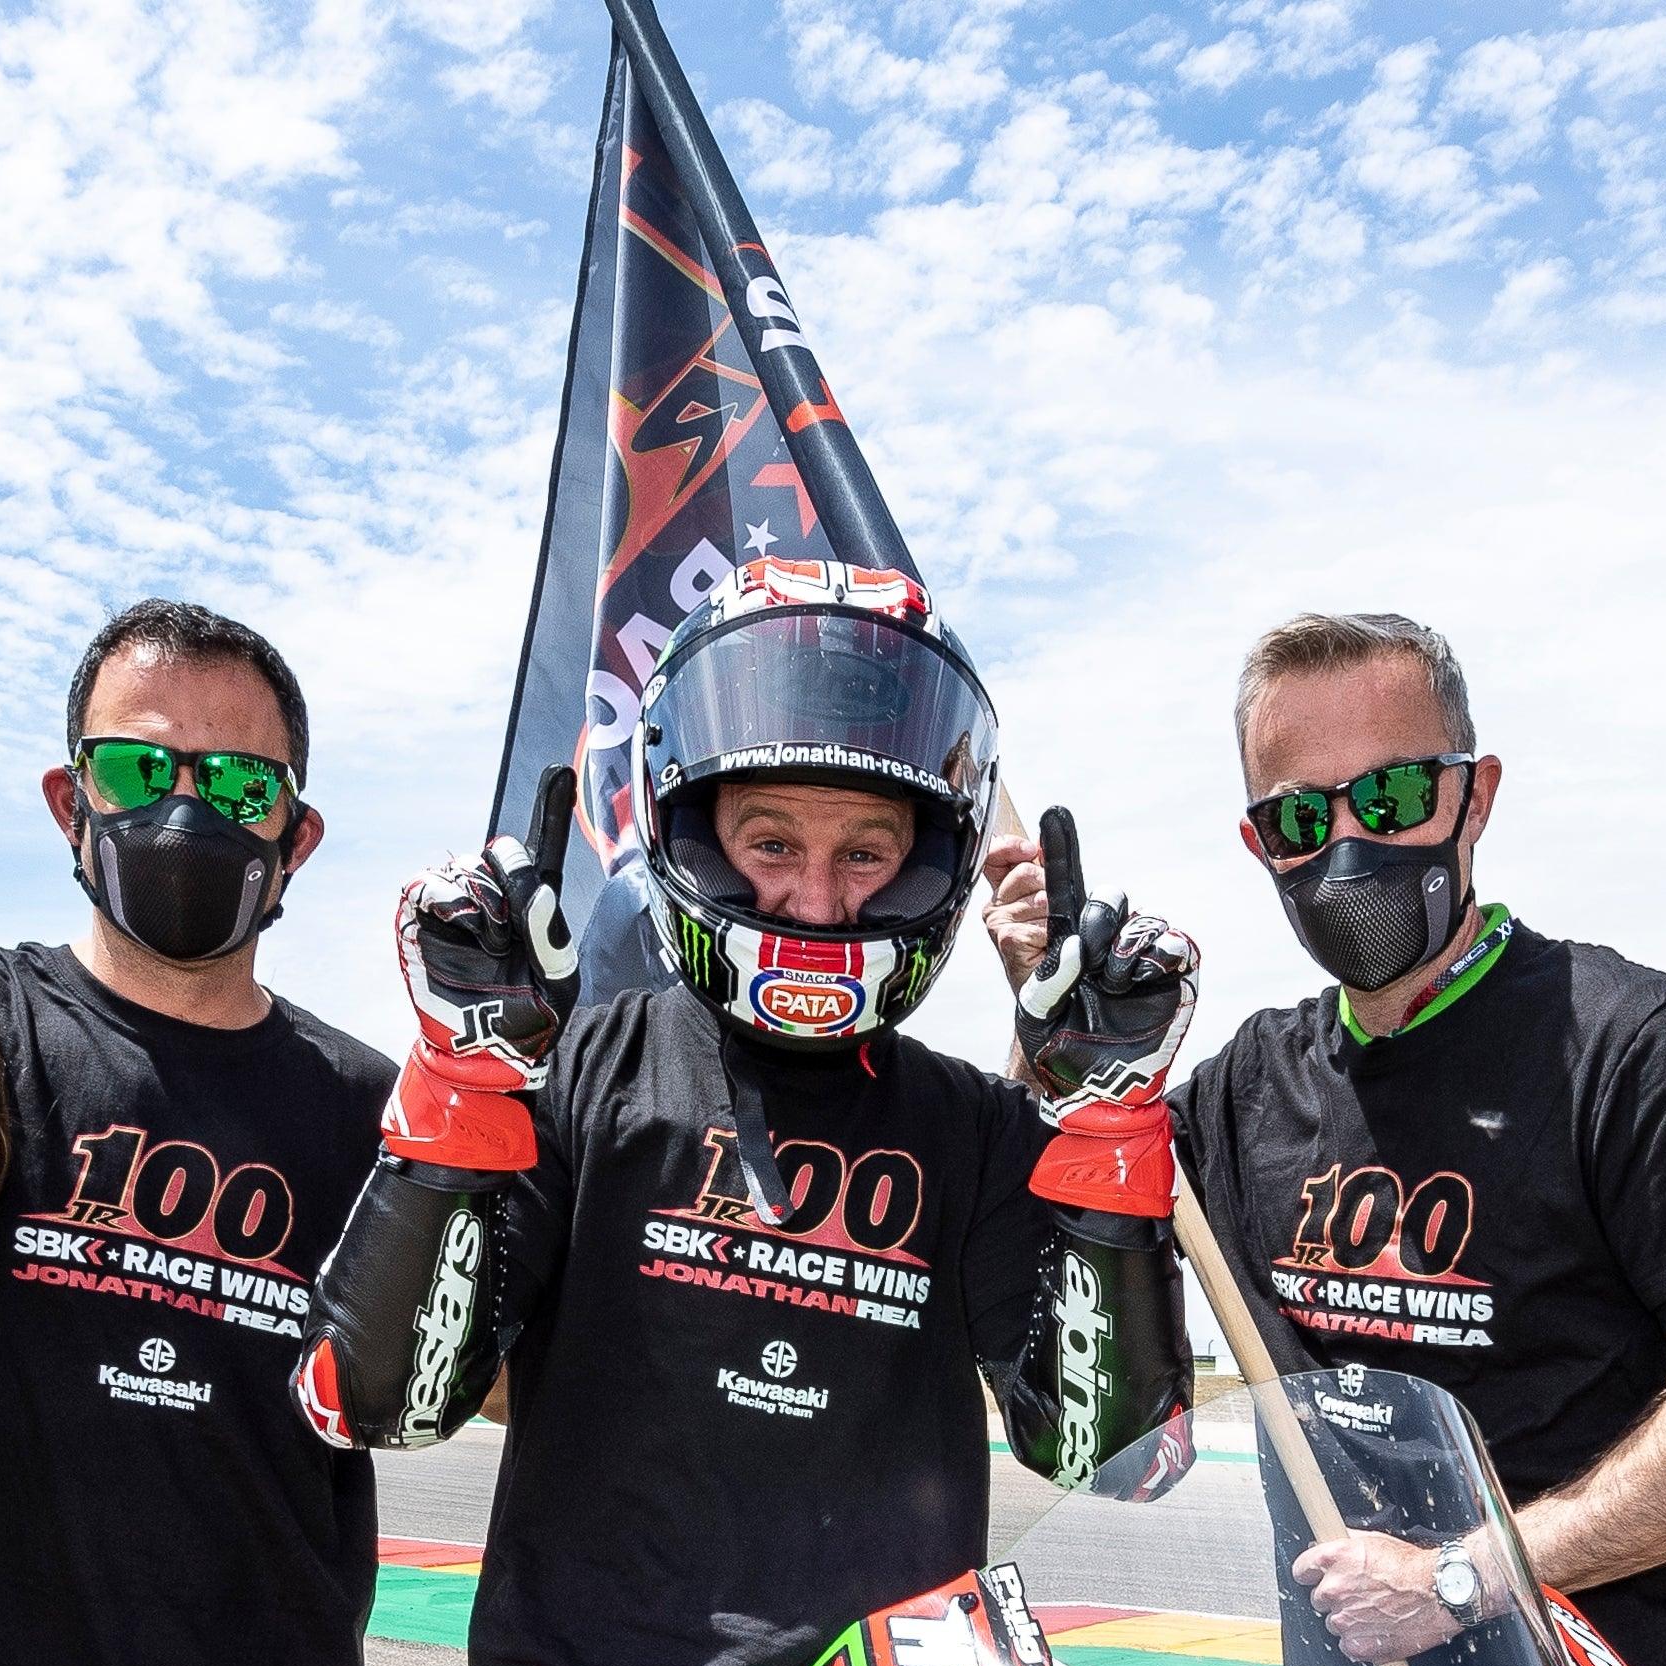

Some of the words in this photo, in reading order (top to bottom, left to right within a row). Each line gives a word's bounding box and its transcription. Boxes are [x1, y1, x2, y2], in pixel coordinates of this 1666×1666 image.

[784, 969, 836, 985] SNACK
[770, 989, 844, 1019] PATA
[71, 1123, 294, 1262] 100
[702, 1126, 924, 1253] 100
[1293, 1163, 1474, 1279] 100
[13, 1226, 93, 1264] SBK
[122, 1242, 214, 1292] RACE
[220, 1267, 311, 1316] WINS
[642, 1220, 721, 1261] SBK
[747, 1240, 846, 1287] RACE
[853, 1260, 931, 1304] WINS
[1326, 1280, 1403, 1315] RACE
[1405, 1287, 1494, 1322] WINS
[98, 1363, 212, 1404] Kawasaki
[109, 1386, 158, 1408] Racing
[158, 1393, 195, 1412] Team
[716, 1367, 830, 1410] Kawasaki
[727, 1391, 776, 1414] Racing
[777, 1399, 814, 1419] Team
